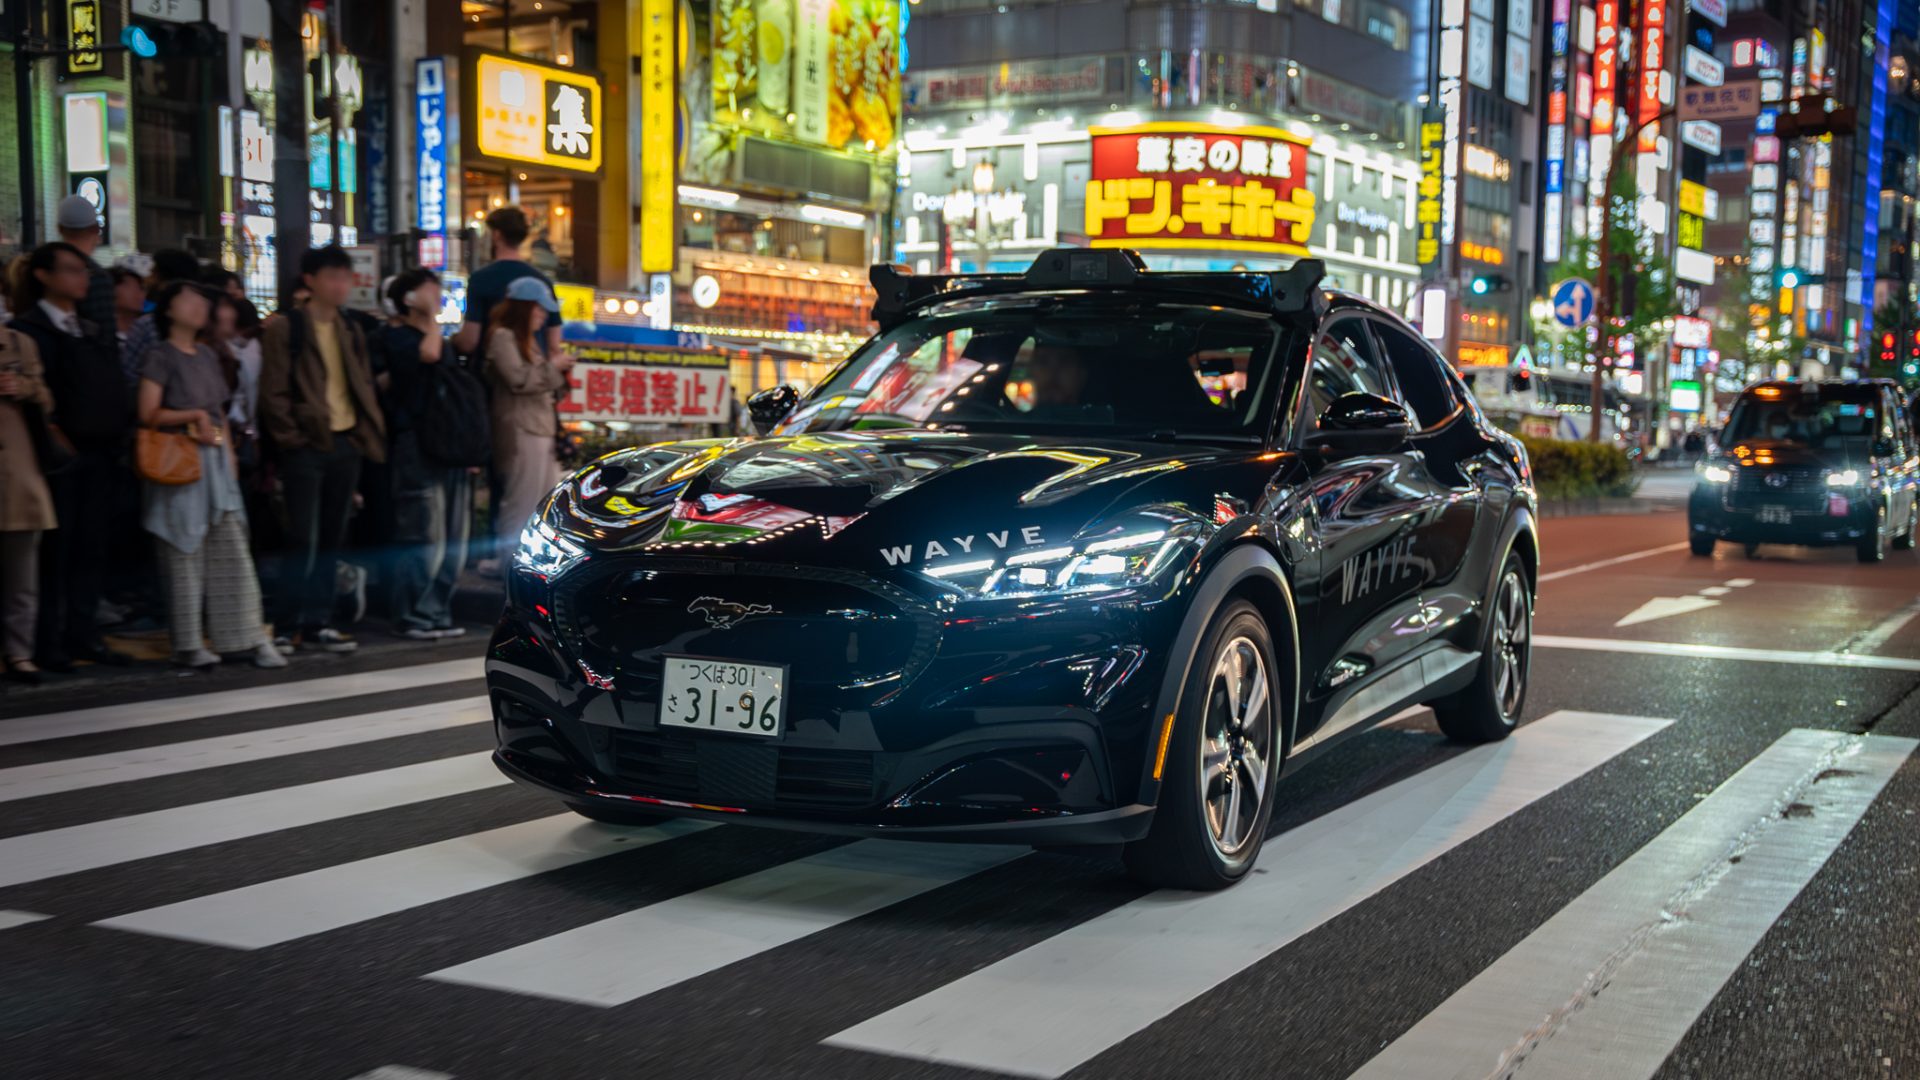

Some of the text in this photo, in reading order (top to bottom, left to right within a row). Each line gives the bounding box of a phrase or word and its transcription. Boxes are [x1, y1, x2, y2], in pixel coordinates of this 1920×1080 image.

[547, 85, 594, 154] 集
[1136, 136, 1292, 179] 驚安の殿堂
[880, 525, 1046, 566] WAYVE
[1342, 535, 1417, 605] WAYVE
[667, 687, 778, 732] さ 31-96
